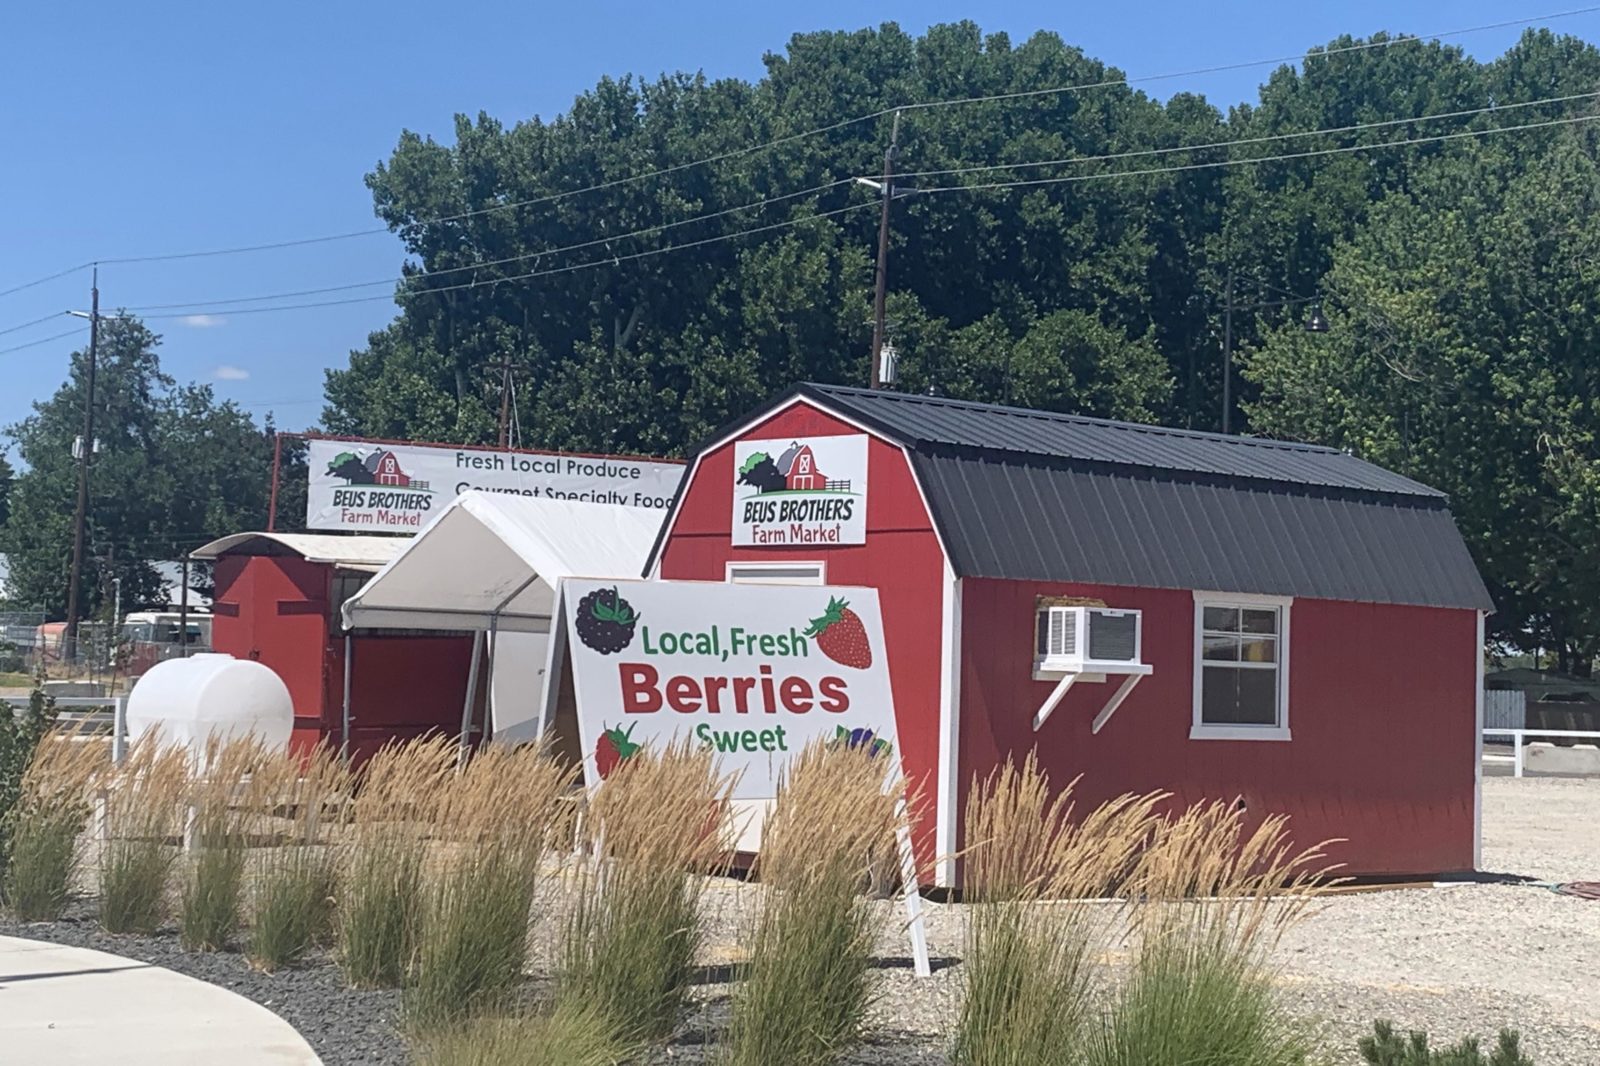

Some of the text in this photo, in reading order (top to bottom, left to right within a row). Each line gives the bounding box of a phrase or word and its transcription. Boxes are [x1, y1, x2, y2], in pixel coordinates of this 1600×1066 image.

[456, 452, 641, 480] Fresh Local Produce
[332, 489, 433, 511] BEUS BROTHERS
[455, 482, 540, 497] Grmet
[341, 508, 421, 526] Farm Market
[743, 498, 854, 524] BEUS BROTHERS
[752, 523, 841, 543] Farm Market
[618, 662, 850, 714] Berries
[696, 723, 788, 753] Sweet
